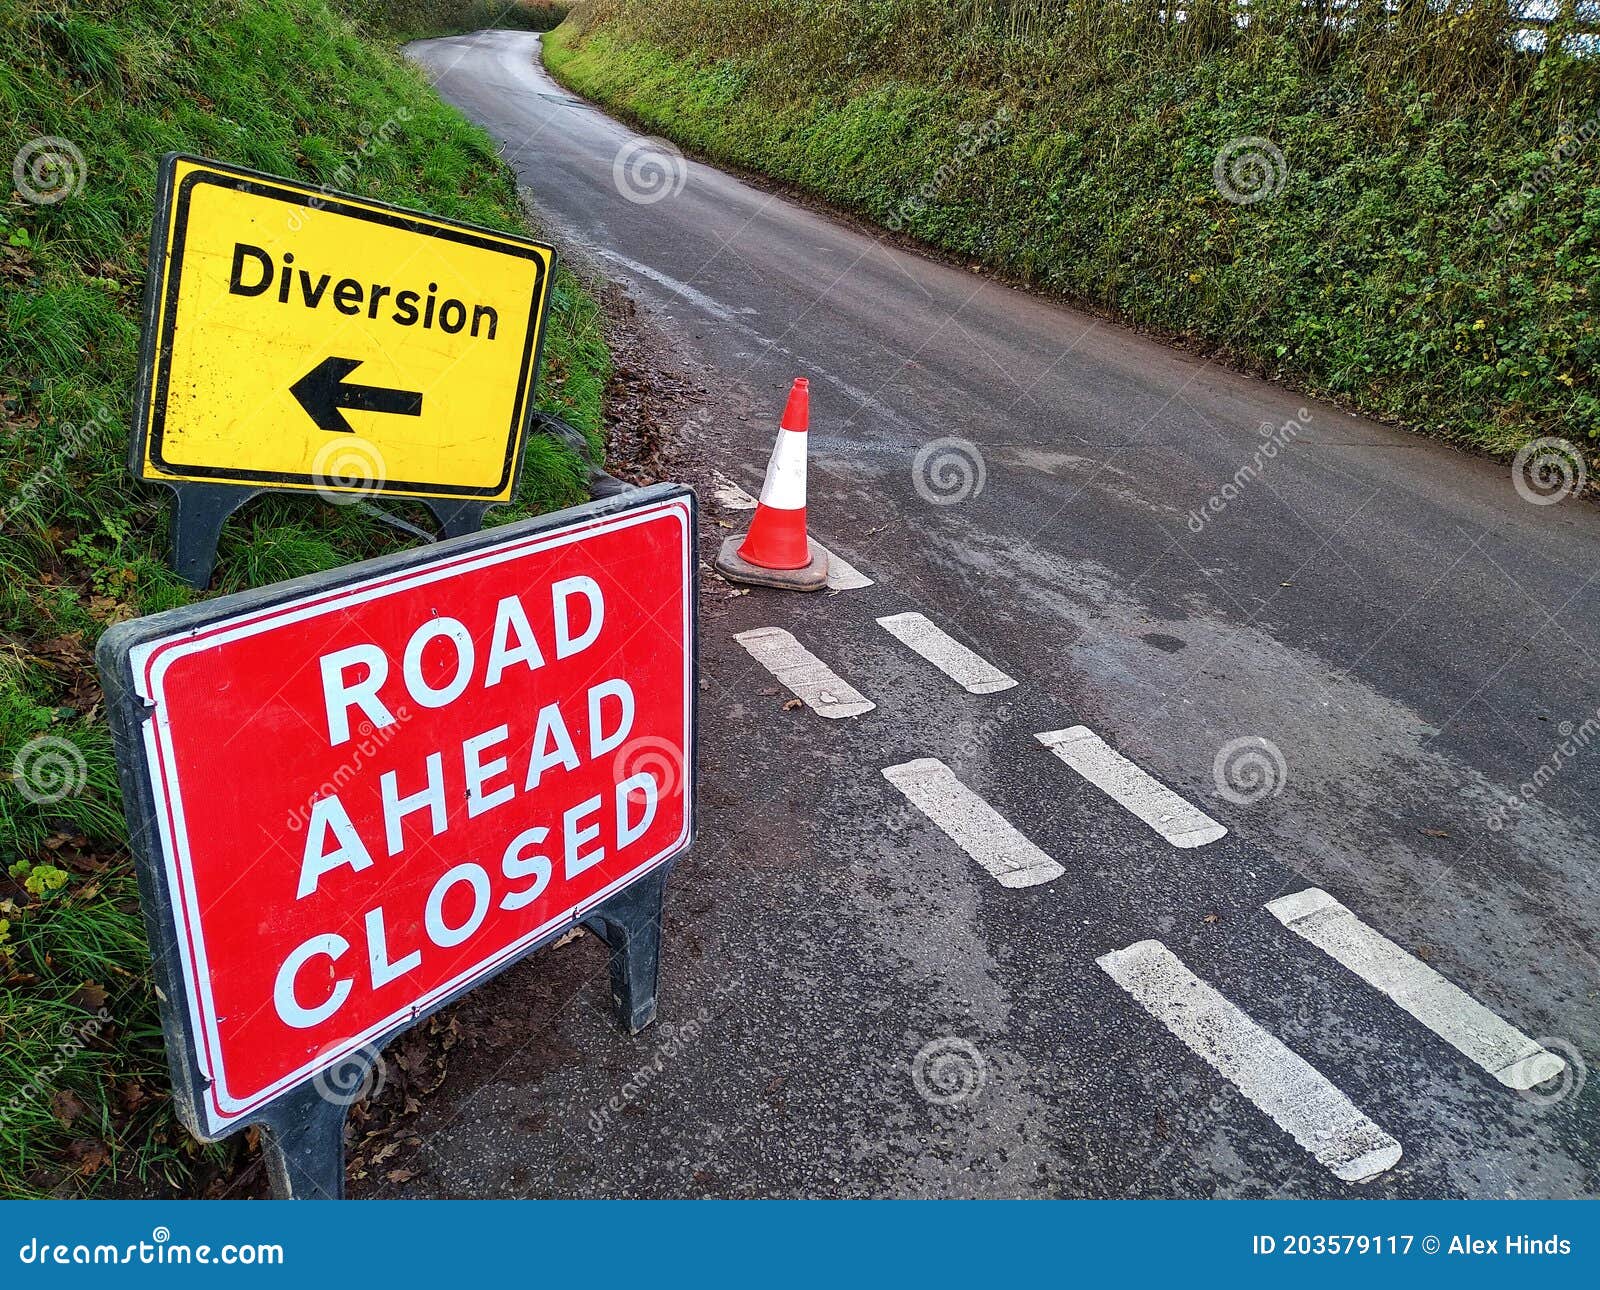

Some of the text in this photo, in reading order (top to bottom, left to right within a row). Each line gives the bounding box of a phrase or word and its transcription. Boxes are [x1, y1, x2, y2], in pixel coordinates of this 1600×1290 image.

[229, 242, 498, 340] Diversion
[319, 574, 605, 747] ROAD
[296, 678, 635, 900] AHEAD
[273, 771, 659, 1029] CLOSED
